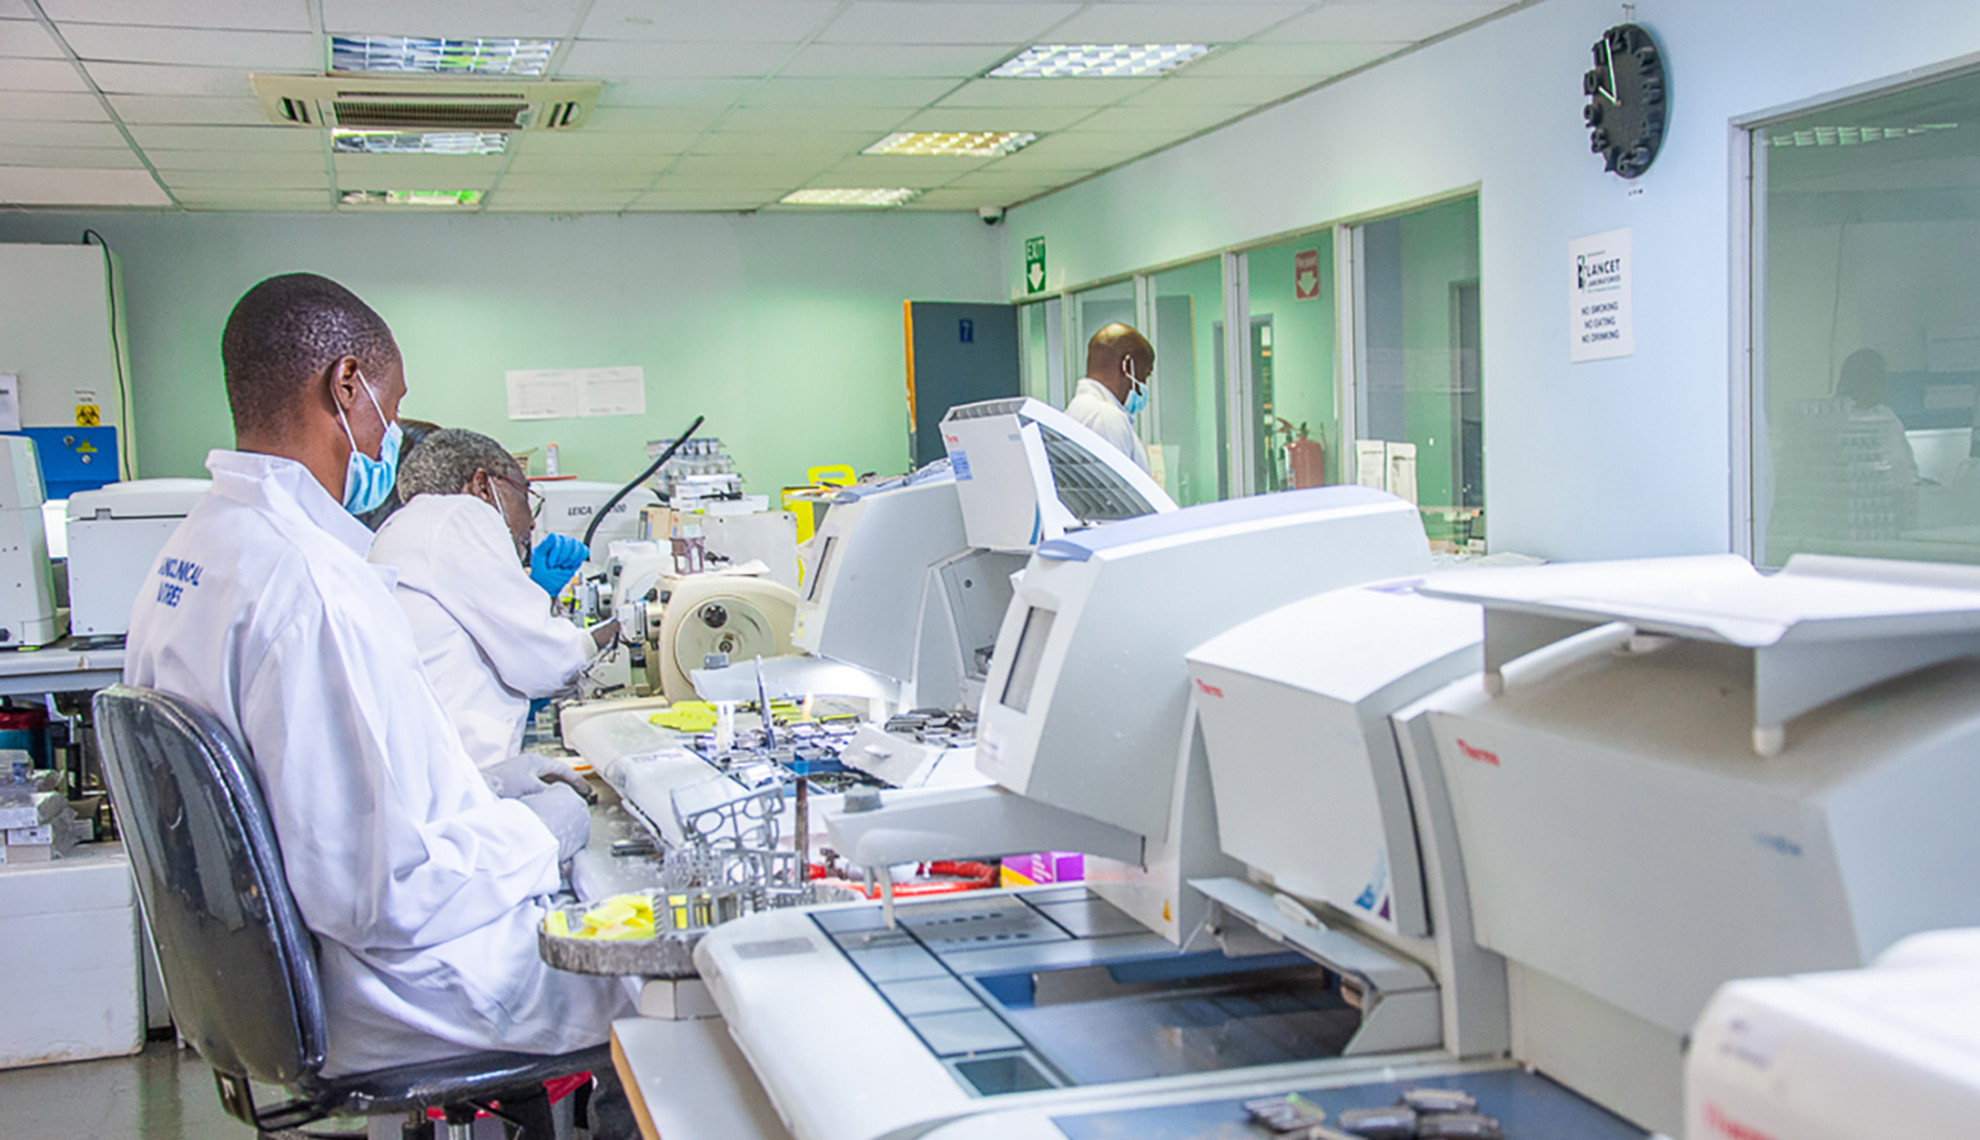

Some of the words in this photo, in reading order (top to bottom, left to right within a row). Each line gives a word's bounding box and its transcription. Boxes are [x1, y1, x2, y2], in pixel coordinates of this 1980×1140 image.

[1027, 239, 1044, 260] EXIT
[1586, 257, 1621, 278] LANCET
[1581, 305, 1590, 315] NO
[1591, 301, 1618, 314] SMOKING
[1584, 319, 1593, 329] NO
[1594, 315, 1616, 329] EATING
[1581, 333, 1590, 343] NO
[1591, 329, 1620, 343] DRINKING
[567, 505, 592, 516] LEICA
